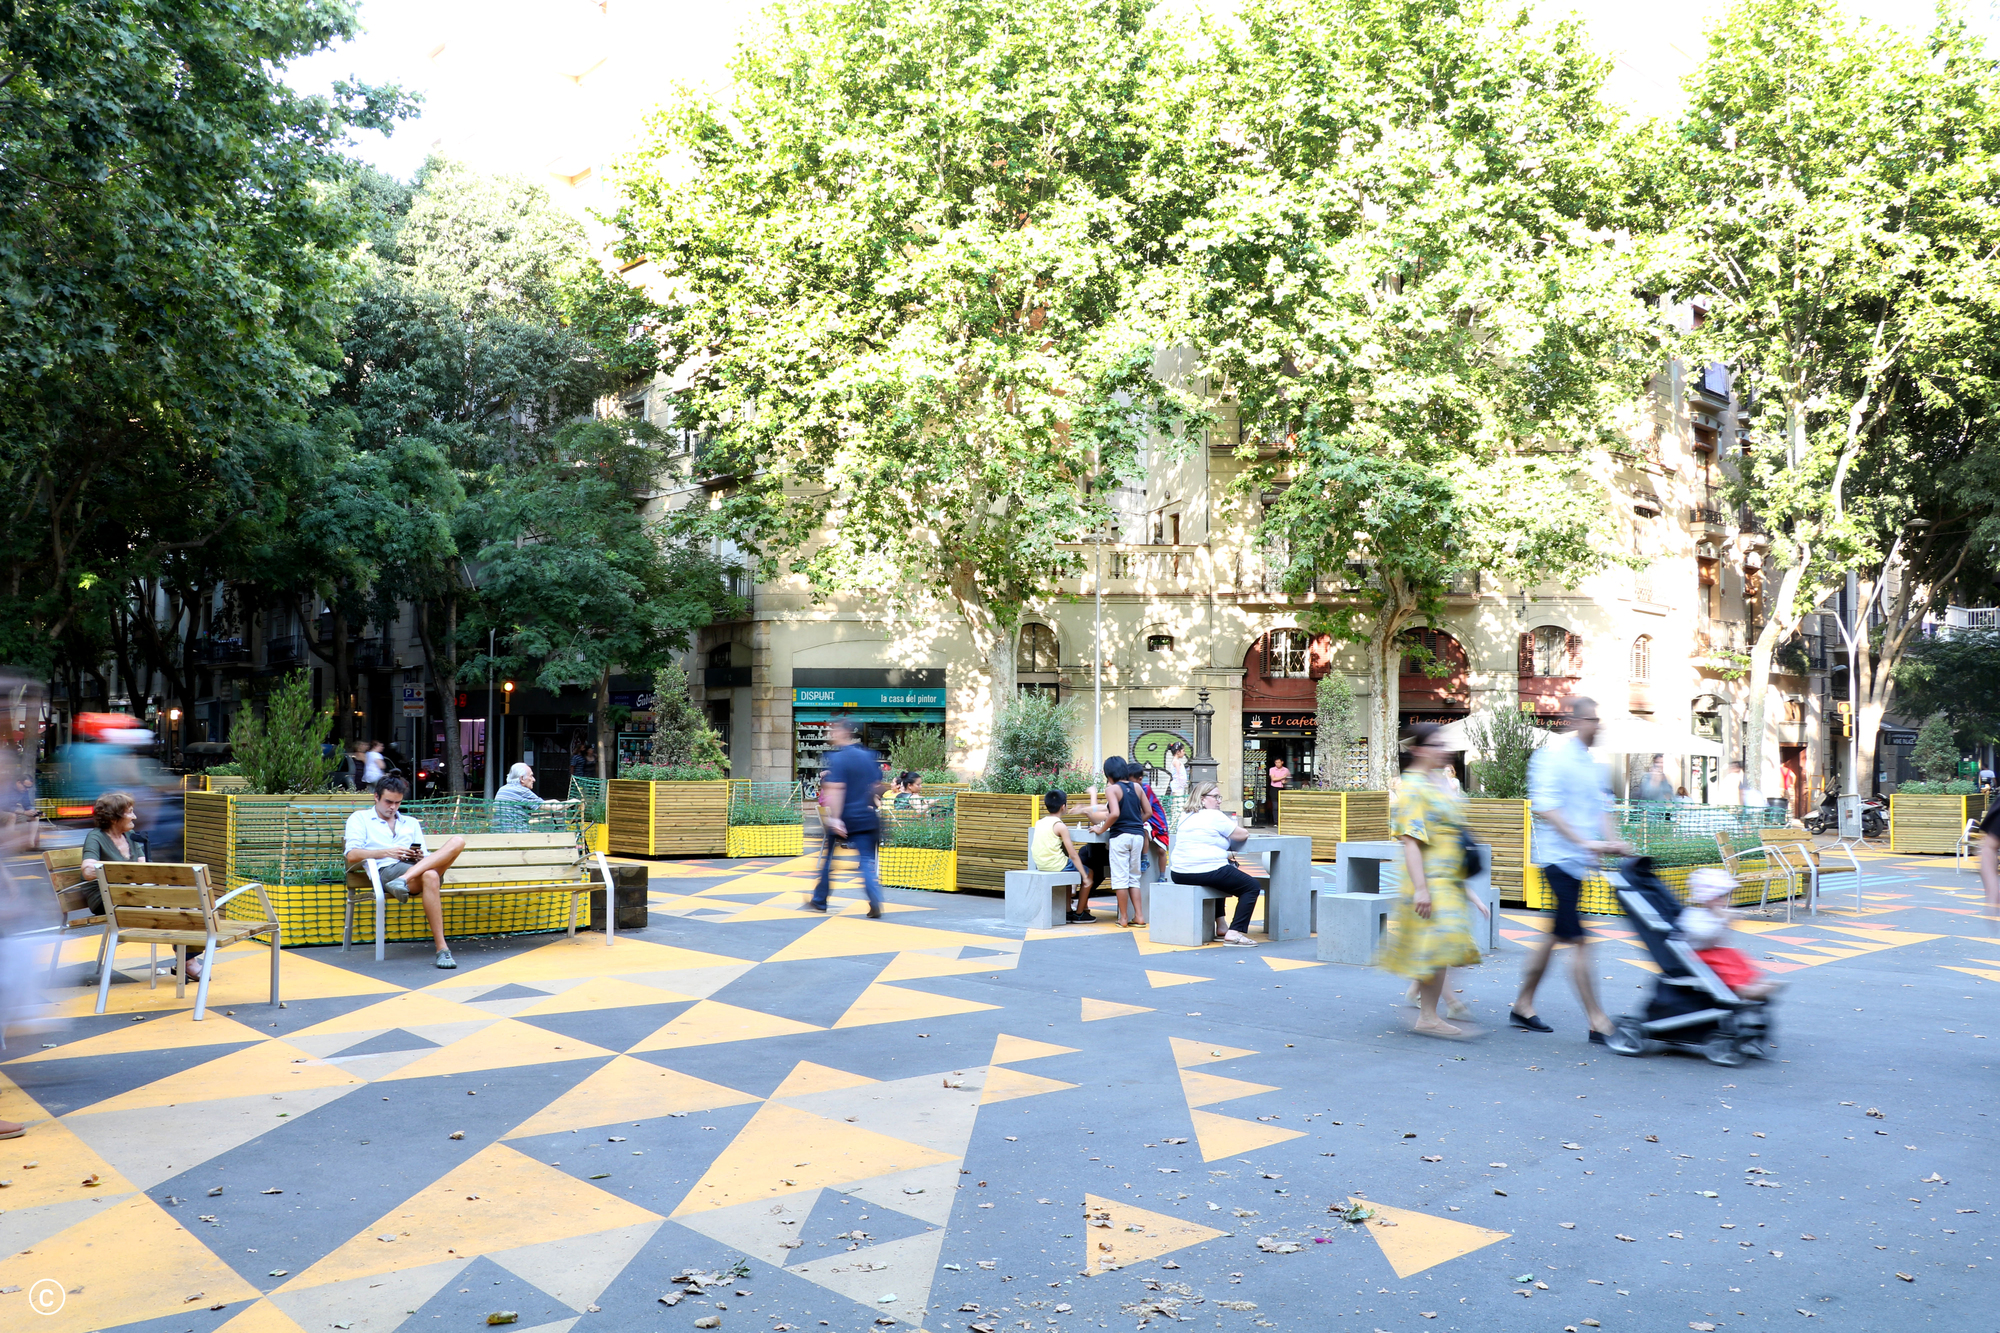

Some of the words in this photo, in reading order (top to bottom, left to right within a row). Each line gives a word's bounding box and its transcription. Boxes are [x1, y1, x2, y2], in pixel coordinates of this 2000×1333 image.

[801, 691, 836, 701] DISPUNT
[880, 694, 888, 703] la
[888, 695, 904, 703] casa
[905, 694, 916, 703] del
[917, 694, 937, 705] pintor
[1271, 715, 1284, 725] El
[1409, 715, 1422, 726] El
